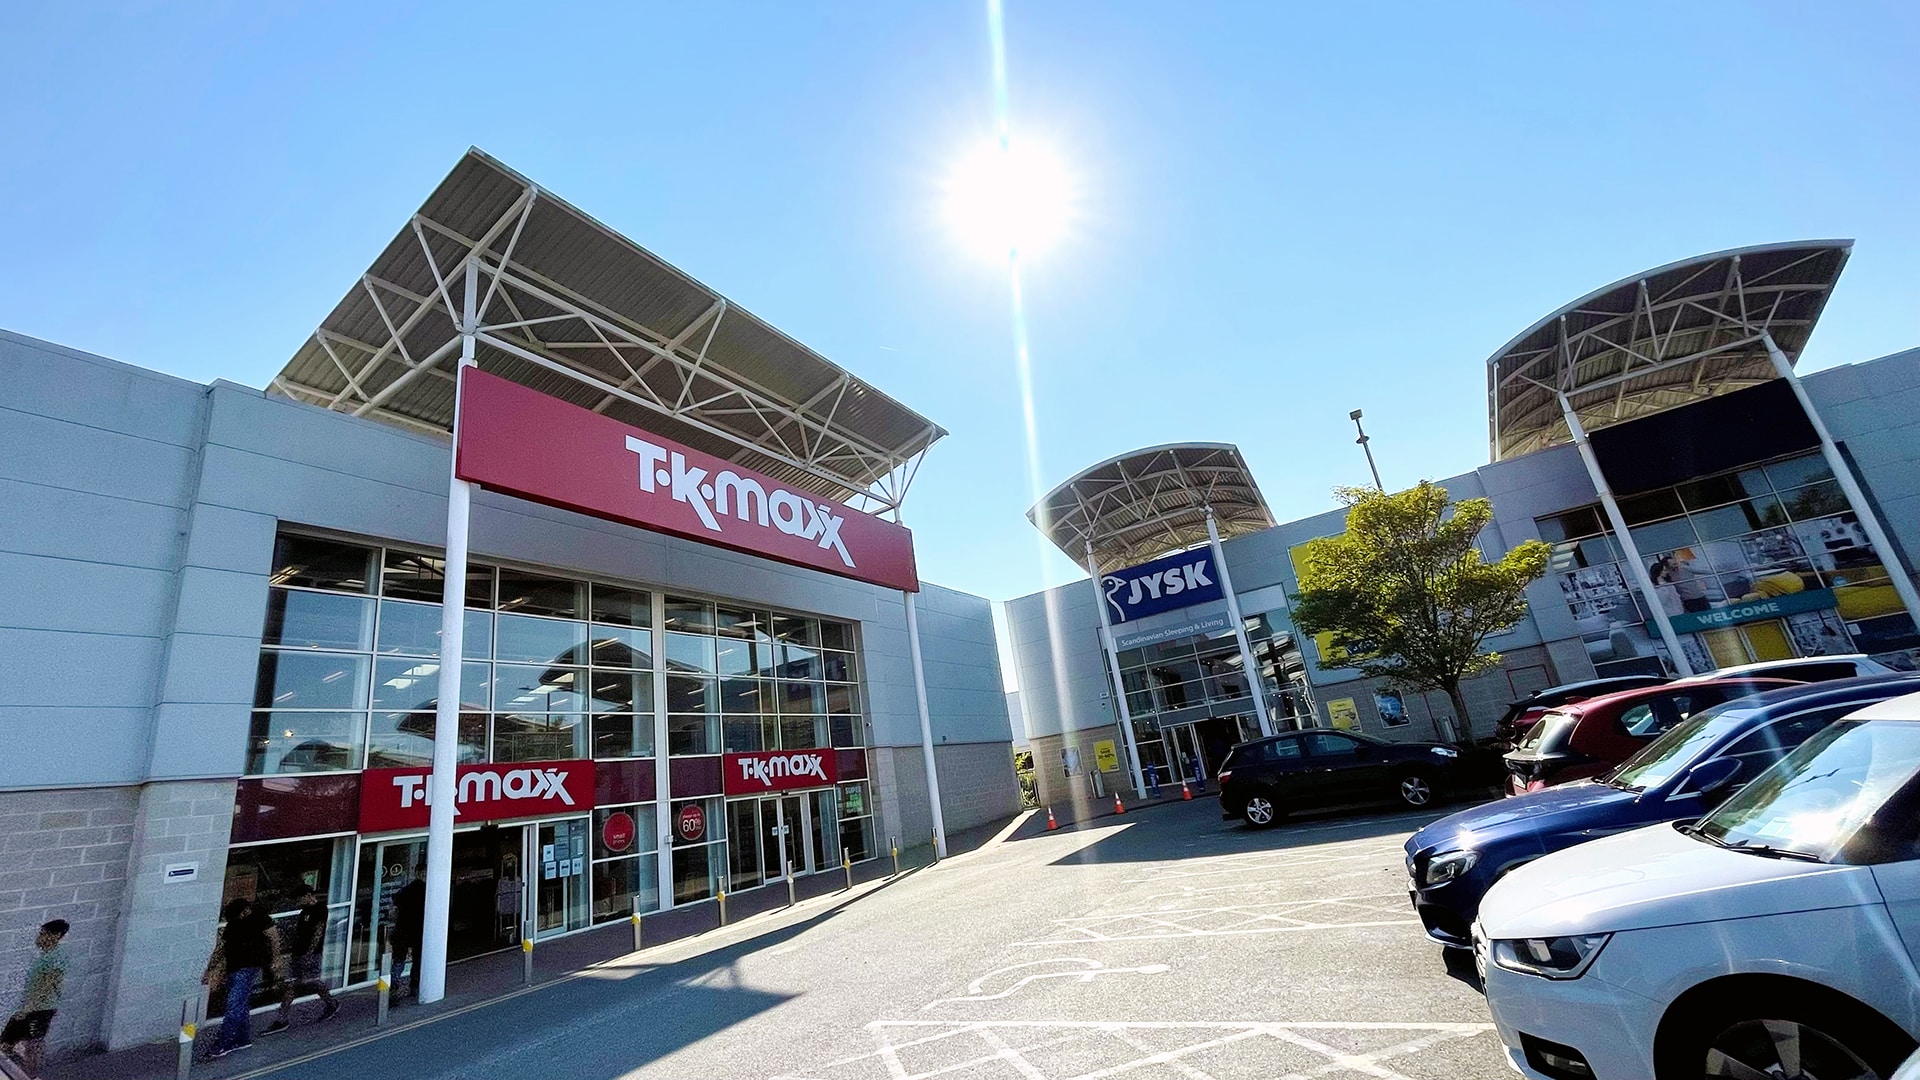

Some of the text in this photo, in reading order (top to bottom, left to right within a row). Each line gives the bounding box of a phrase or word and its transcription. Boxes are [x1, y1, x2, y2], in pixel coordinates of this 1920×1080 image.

[1128, 560, 1213, 605] JYSK
[1696, 602, 1780, 624] WELCOME
[1121, 632, 1164, 647] Scandinavian
[1164, 625, 1194, 637] Sleeping
[1201, 618, 1224, 629] Living
